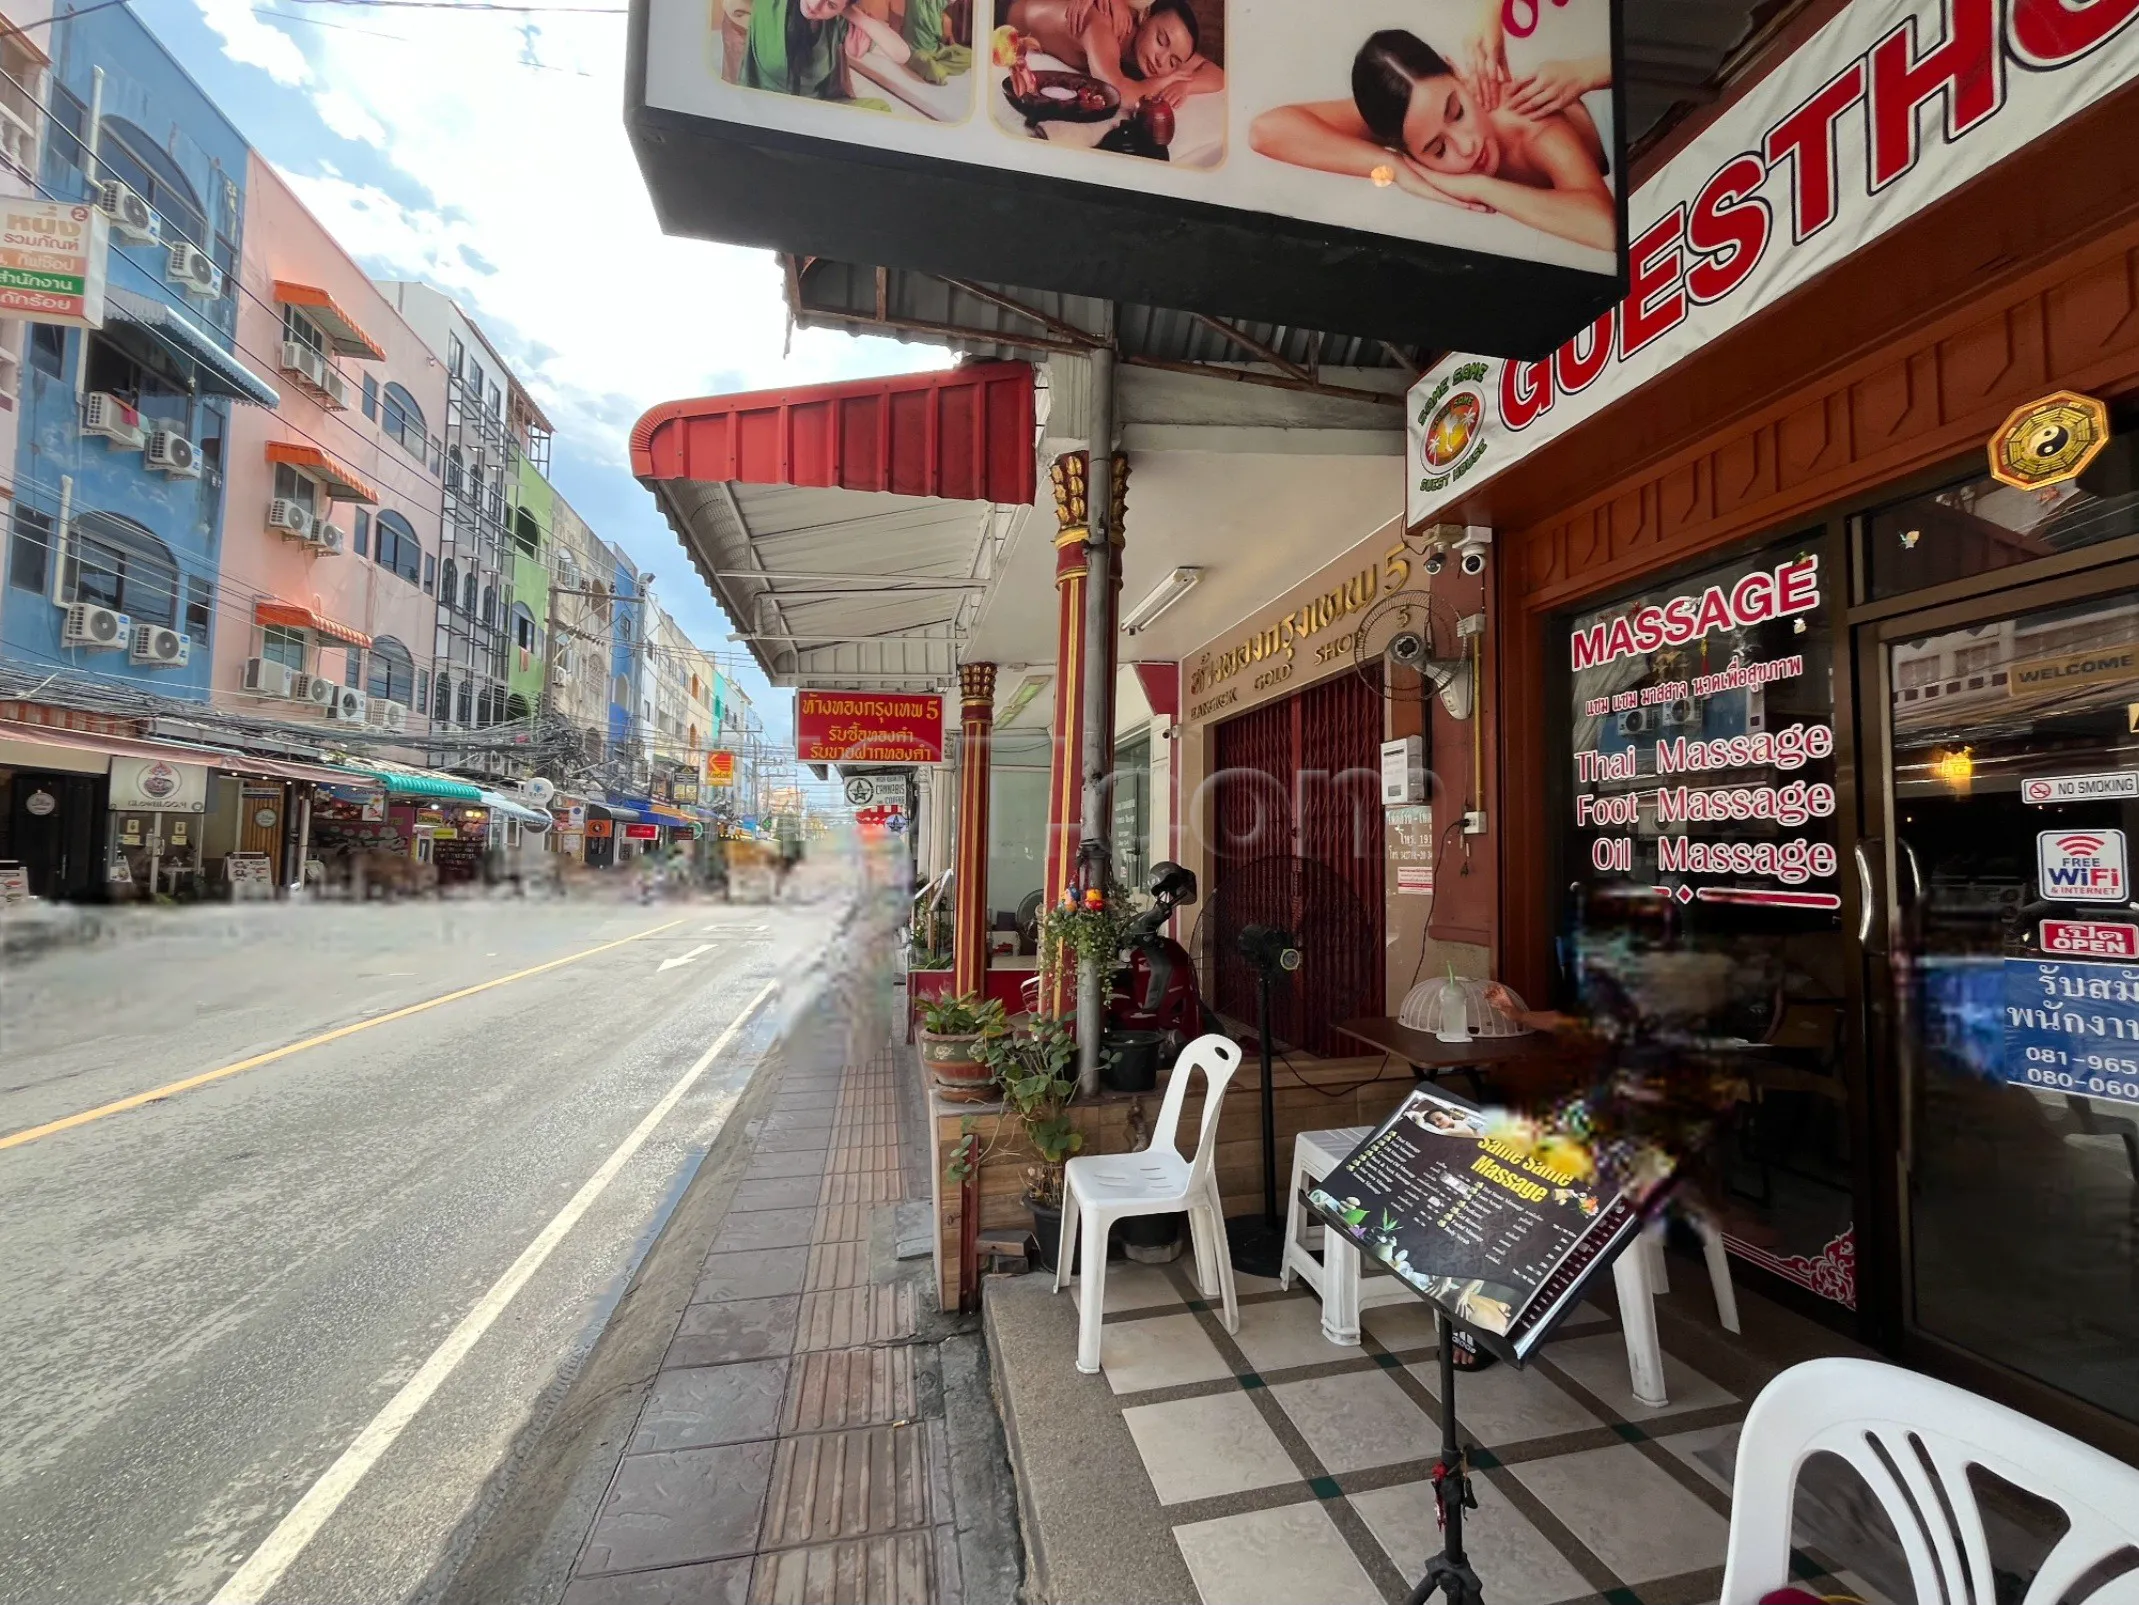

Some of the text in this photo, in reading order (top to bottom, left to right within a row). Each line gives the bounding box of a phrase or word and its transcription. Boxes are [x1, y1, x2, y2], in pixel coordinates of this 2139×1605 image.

[1418, 362, 1489, 426] SAME SAME
[1420, 438, 1488, 492] GUEST HOUSE
[1383, 543, 1410, 595] 5
[1571, 554, 1821, 672] MASSAGE
[1692, 656, 1803, 697] นวดเพื่อสุขภาพ
[2018, 654, 2135, 684] WELCOME
[1190, 687, 1238, 720] BANGKOK
[1254, 662, 1293, 691] GOLD
[926, 700, 939, 720] 5
[828, 721, 914, 743] รับซื้อทองคำ
[1574, 723, 1834, 784] Thai Massage
[875, 784, 905, 795] CANNABIS
[2057, 777, 2134, 796] NO SMOKING
[1576, 780, 1836, 827] Foot Massage
[1592, 836, 1837, 885] Oil Massage
[2062, 857, 2101, 868] FREE
[2048, 867, 2119, 887] WiFi
[2060, 886, 2117, 896] INTERNET
[2053, 938, 2127, 954] OPEN
[2058, 925, 2123, 942] เปิด
[2026, 1046, 2138, 1075] 081-965
[1470, 1154, 1549, 1203] Massage
